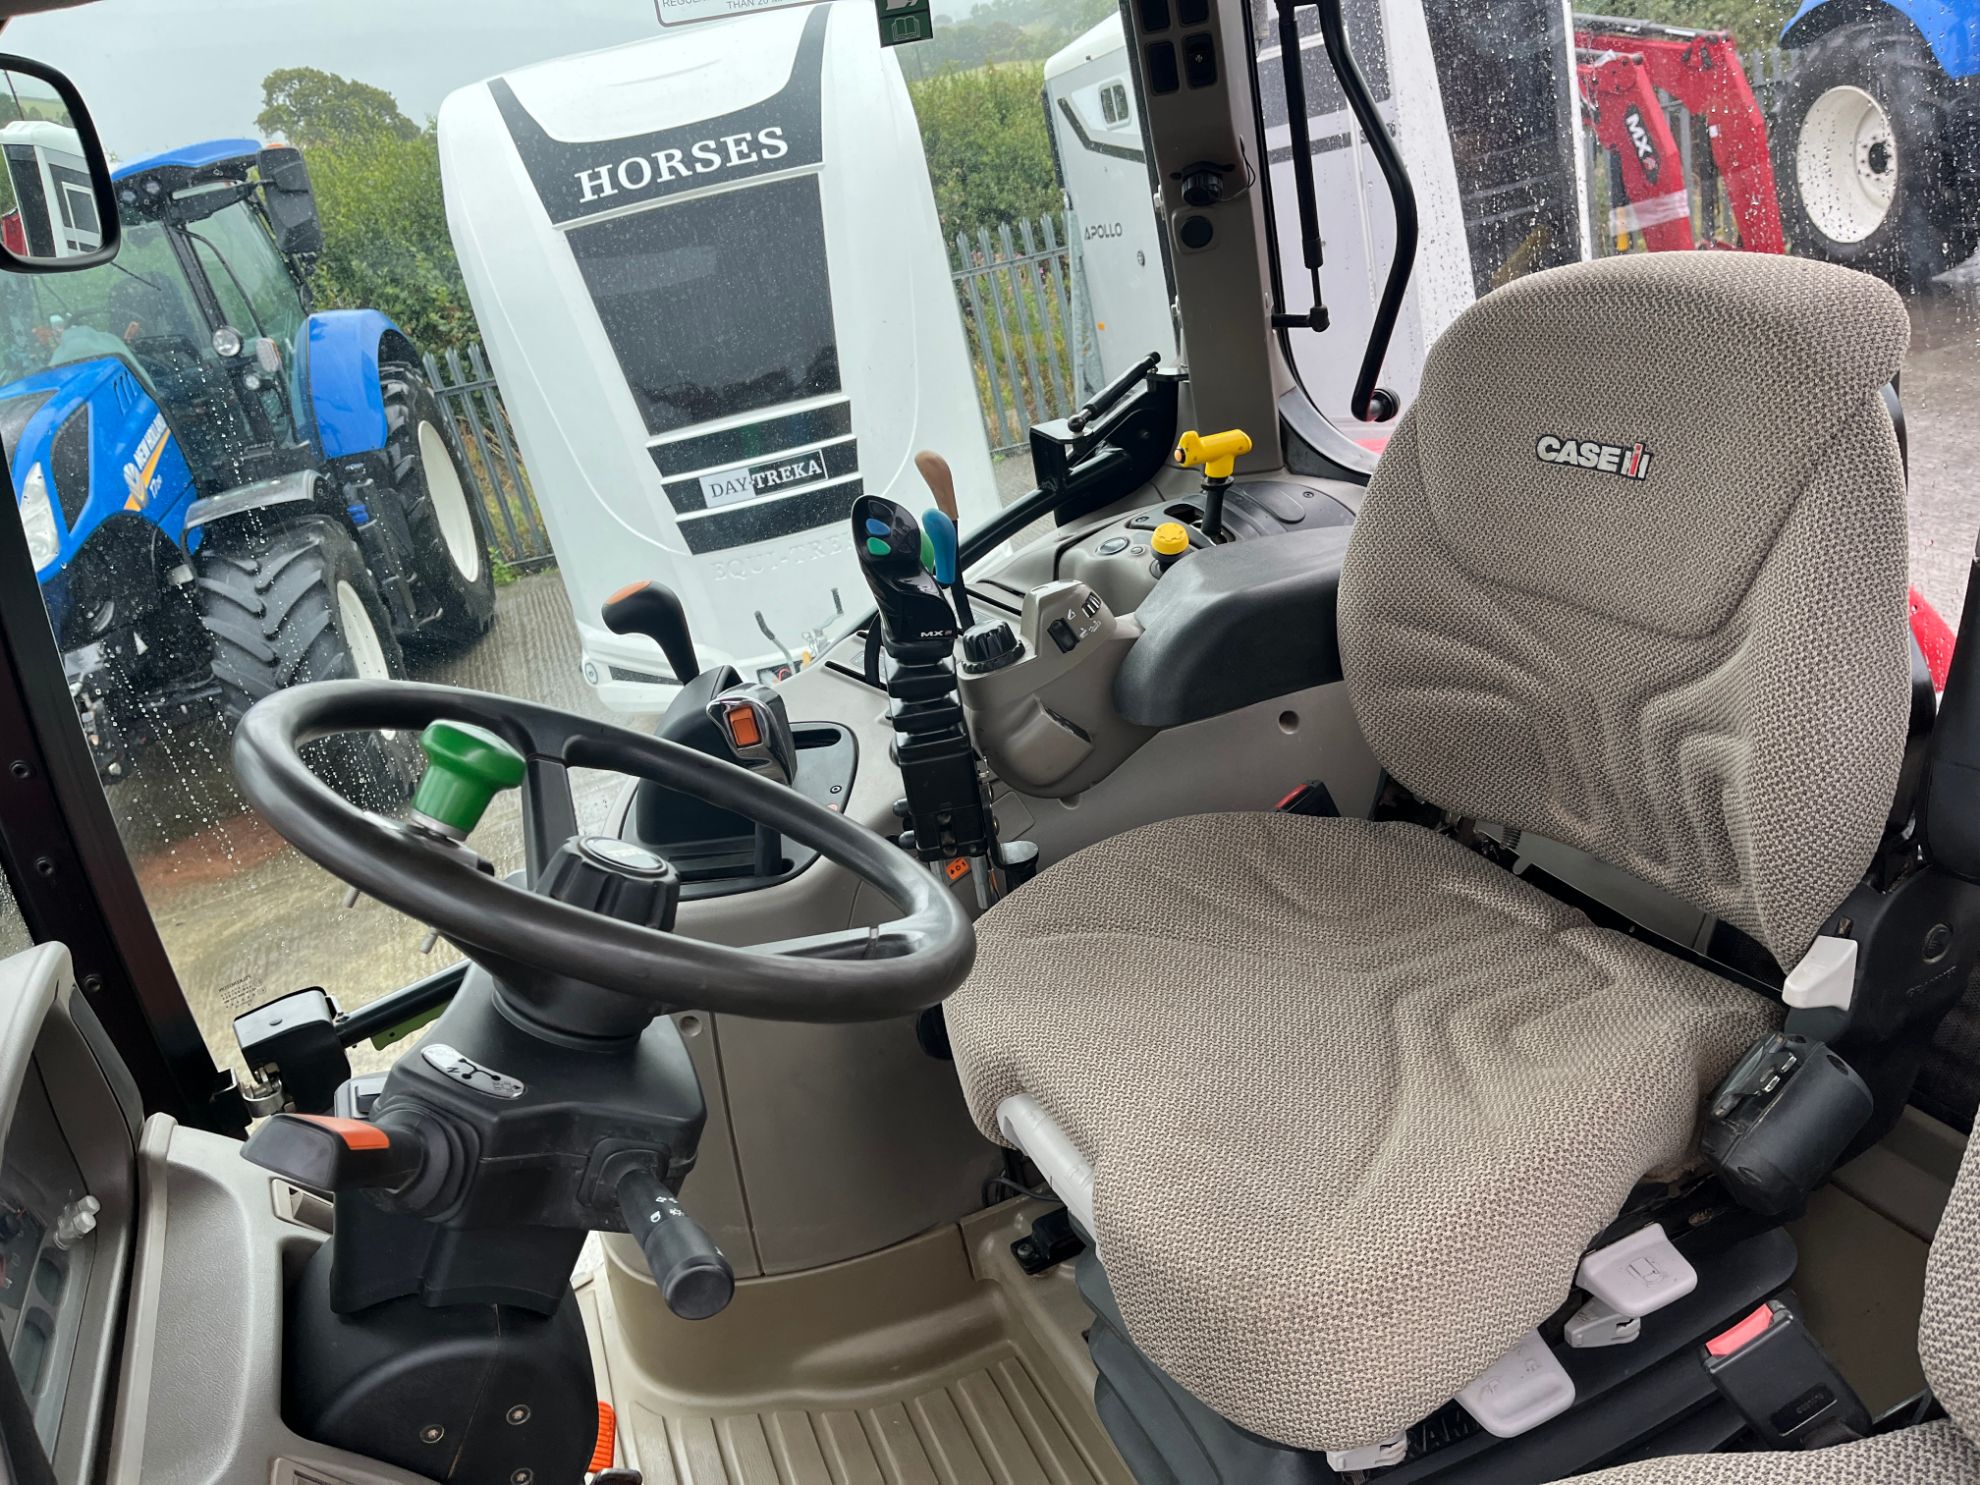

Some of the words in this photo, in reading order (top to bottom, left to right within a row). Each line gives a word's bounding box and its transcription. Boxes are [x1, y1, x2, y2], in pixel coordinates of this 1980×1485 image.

[1625, 113, 1652, 158] MX
[574, 126, 788, 203] HORSES
[1084, 222, 1122, 240] APOLLO
[1536, 435, 1621, 472] CASE
